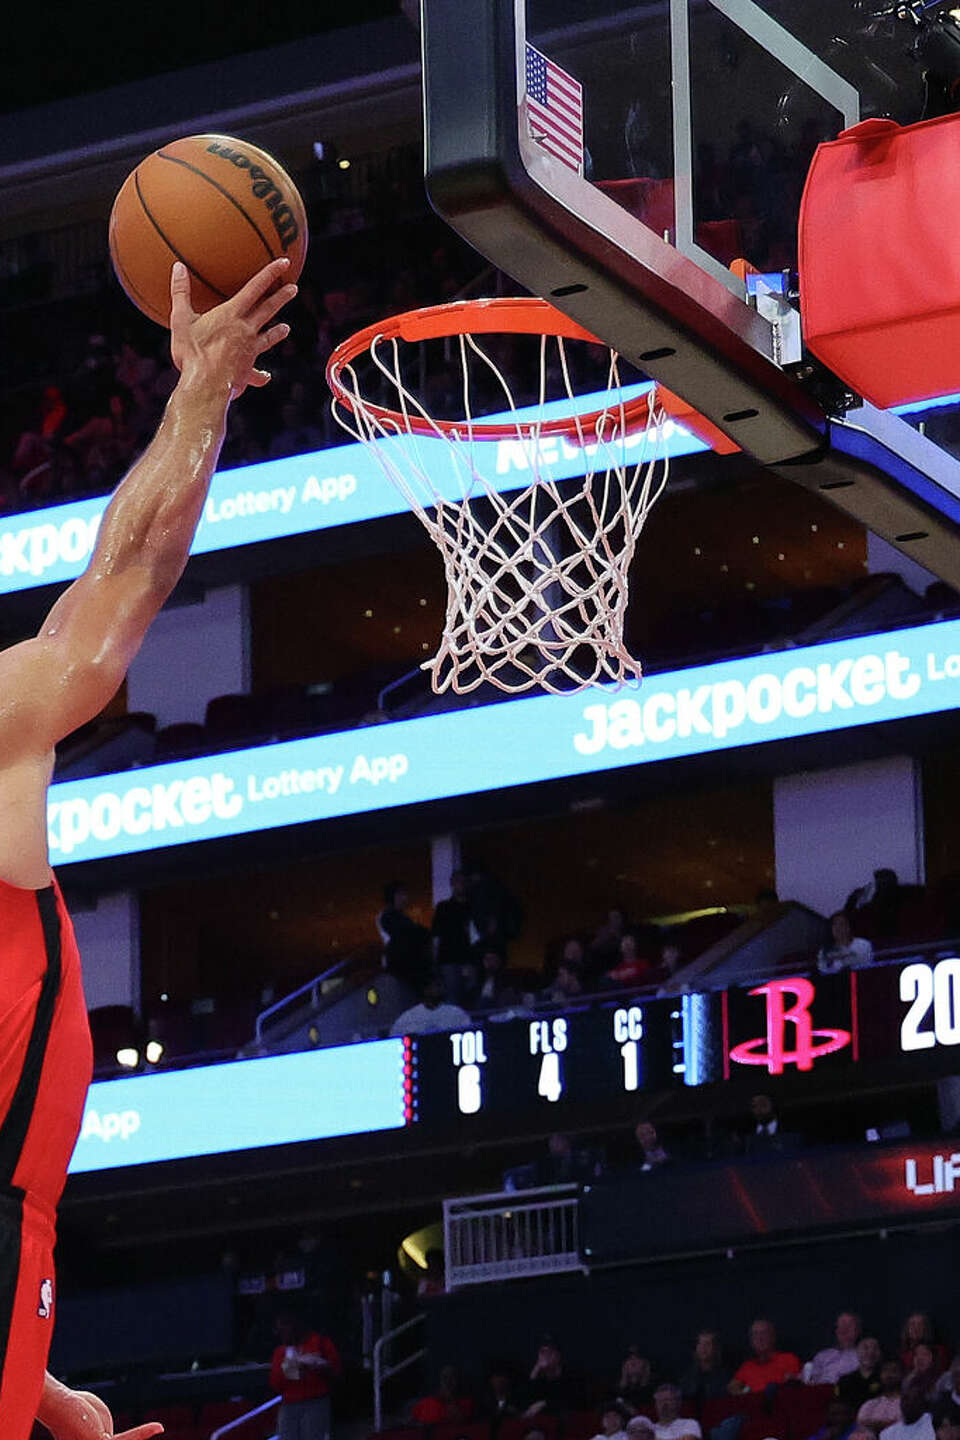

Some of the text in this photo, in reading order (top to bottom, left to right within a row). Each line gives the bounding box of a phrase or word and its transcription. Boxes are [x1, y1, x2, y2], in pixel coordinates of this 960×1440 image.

[206, 486, 296, 523] Lottery
[302, 473, 357, 505] App
[247, 764, 344, 801] Lottery
[349, 753, 409, 786] App
[900, 958, 960, 1051] 20
[450, 1007, 642, 1066] TOL FLS CC
[538, 1052, 562, 1102] 4
[621, 1041, 638, 1091] 1
[82, 1109, 140, 1142] App
